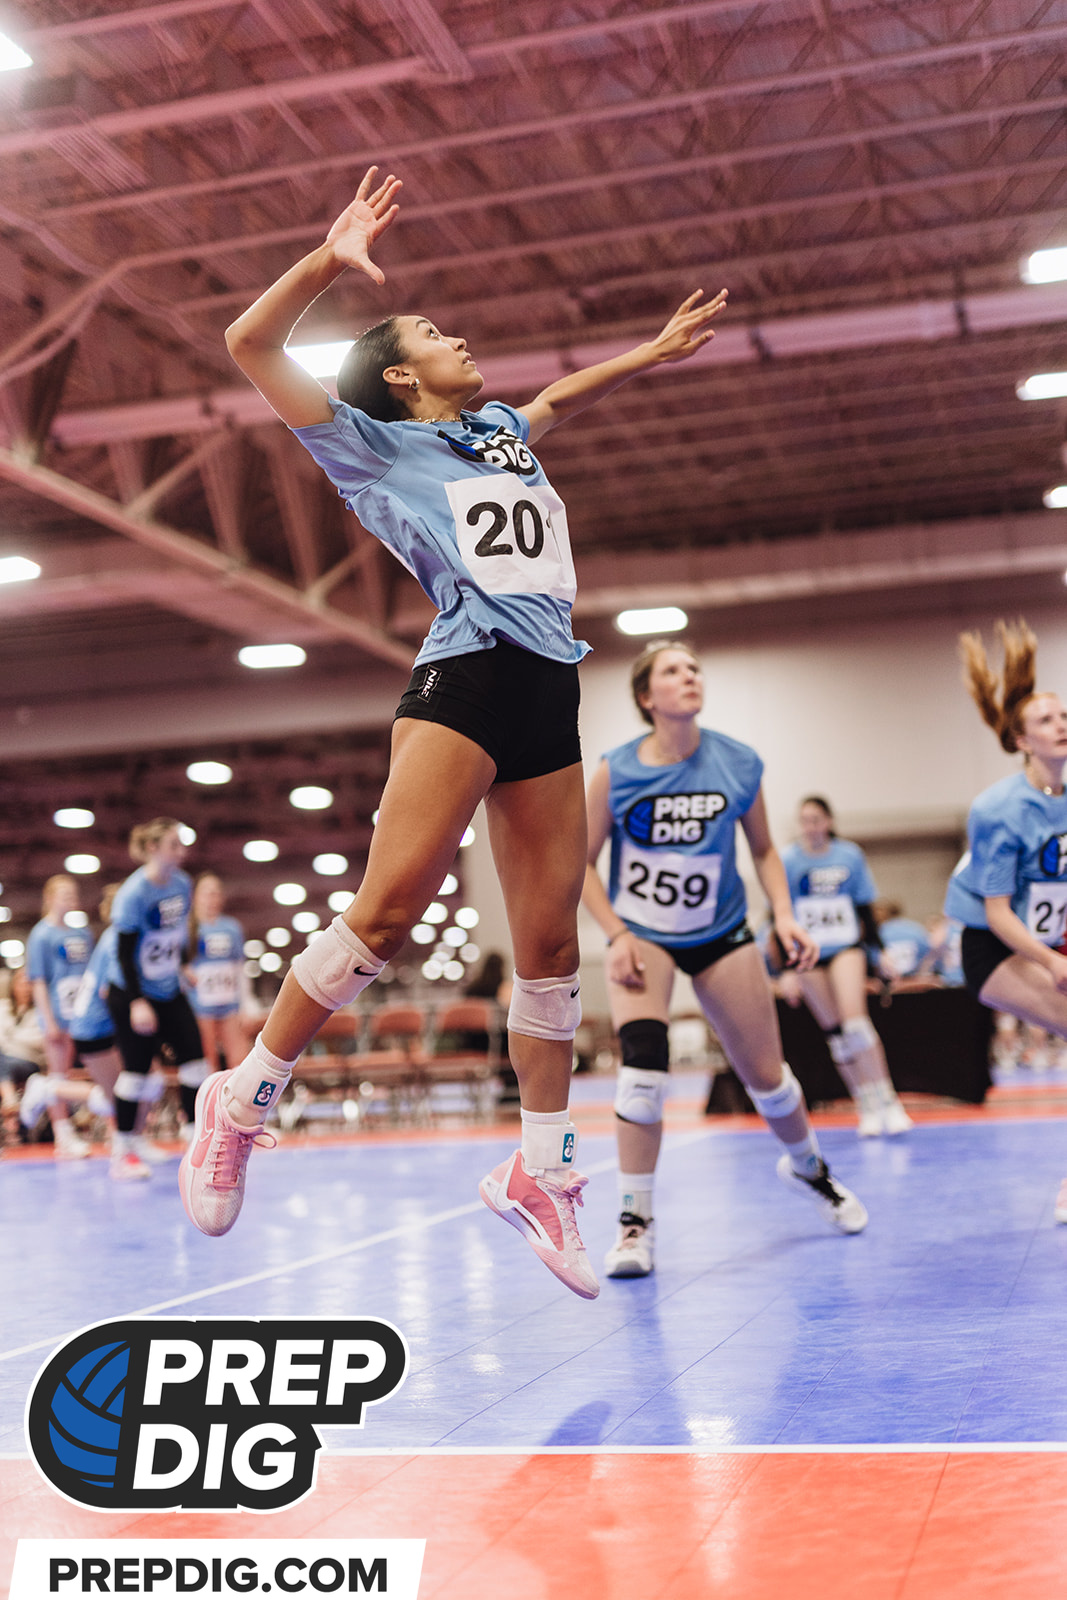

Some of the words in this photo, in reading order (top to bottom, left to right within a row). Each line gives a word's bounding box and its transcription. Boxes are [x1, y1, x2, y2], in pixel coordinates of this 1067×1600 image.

[484, 442, 533, 469] DIG
[653, 793, 725, 821] PREP
[651, 820, 702, 844] DIG
[627, 861, 709, 909] 259
